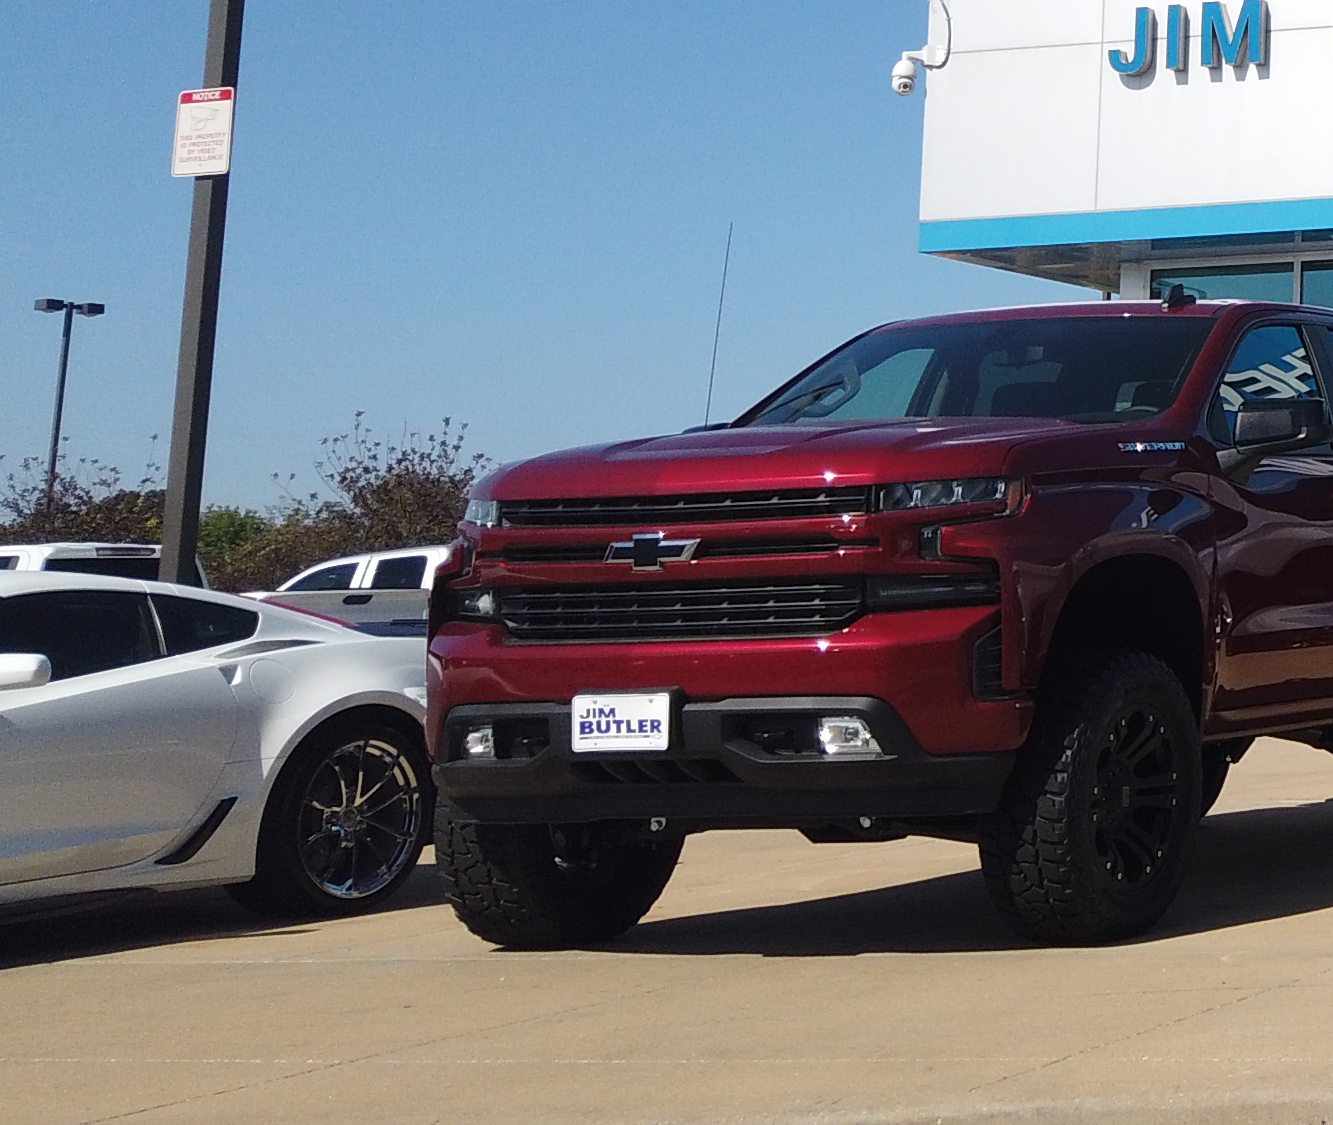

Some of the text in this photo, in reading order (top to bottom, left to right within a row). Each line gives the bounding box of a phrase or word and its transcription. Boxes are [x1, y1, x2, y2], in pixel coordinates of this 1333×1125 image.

[192, 91, 221, 100] NOTICE
[179, 155, 223, 163] SURVEILLANCE
[579, 707, 617, 719] JIM
[579, 718, 663, 735] BUTLER
